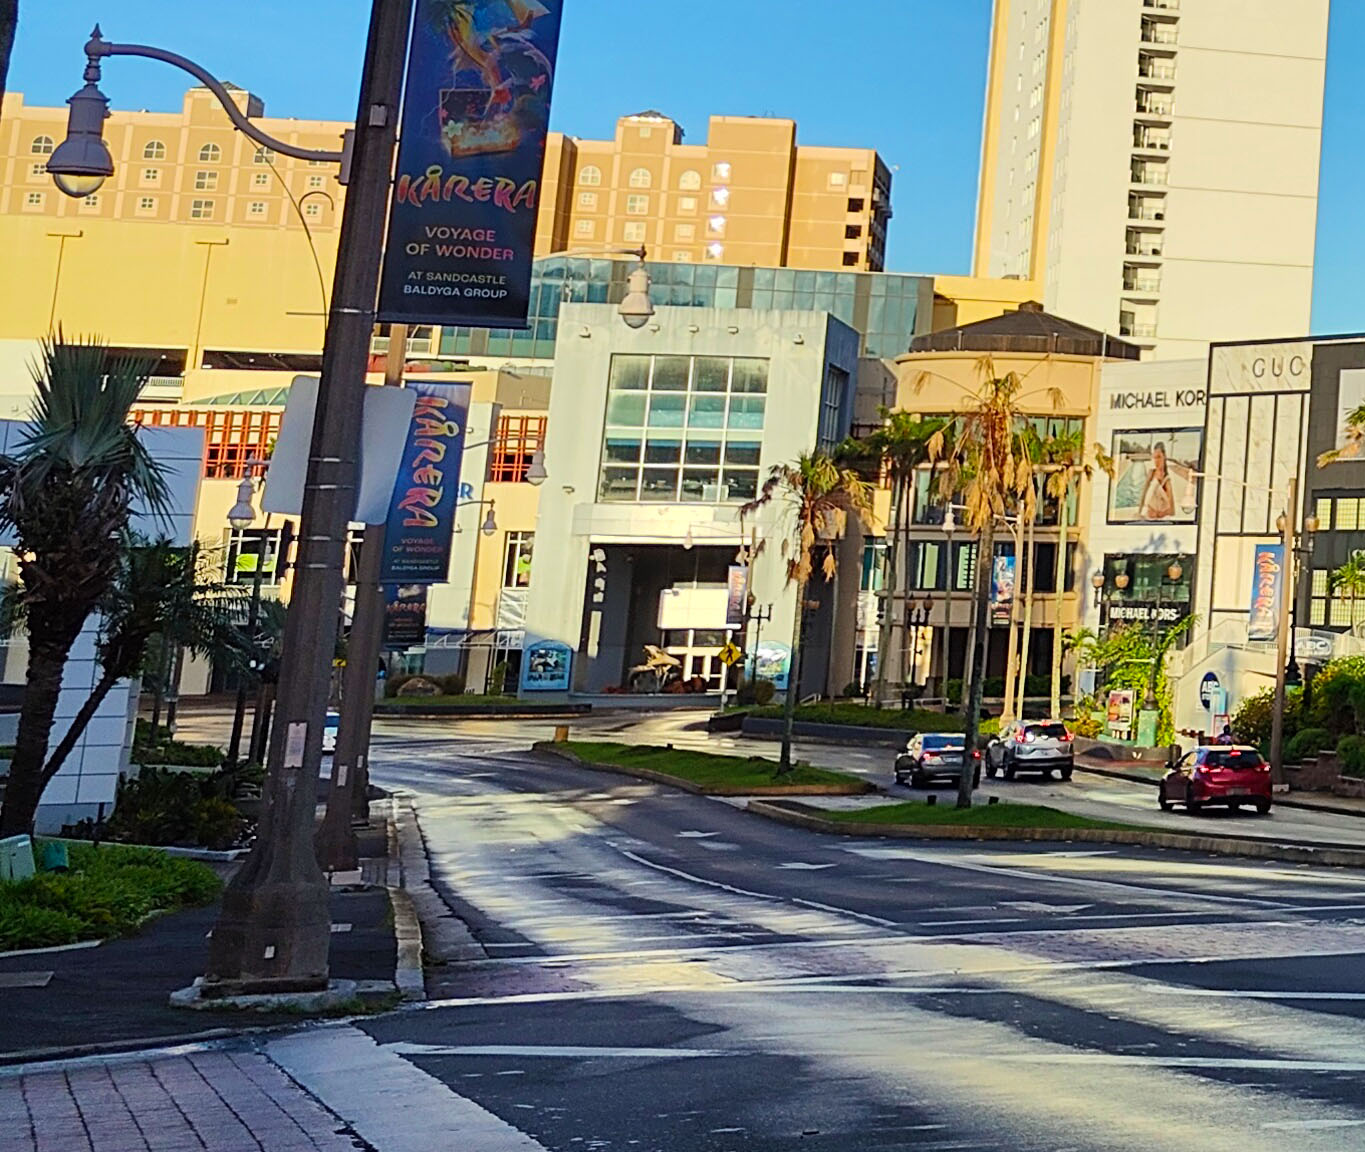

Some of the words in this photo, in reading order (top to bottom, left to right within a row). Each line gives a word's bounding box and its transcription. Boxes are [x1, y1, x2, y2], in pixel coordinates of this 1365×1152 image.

[425, 226, 496, 242] VOYAGE
[405, 243, 430, 256] OF
[435, 244, 514, 261] WONDER
[408, 271, 424, 280] AT
[426, 271, 507, 285] SANDCASTLE
[403, 285, 461, 297] BALDYGA
[463, 287, 508, 299] GROUP
[1110, 392, 1170, 410] MICHAEL
[1110, 606, 1150, 620] MICHAEL
